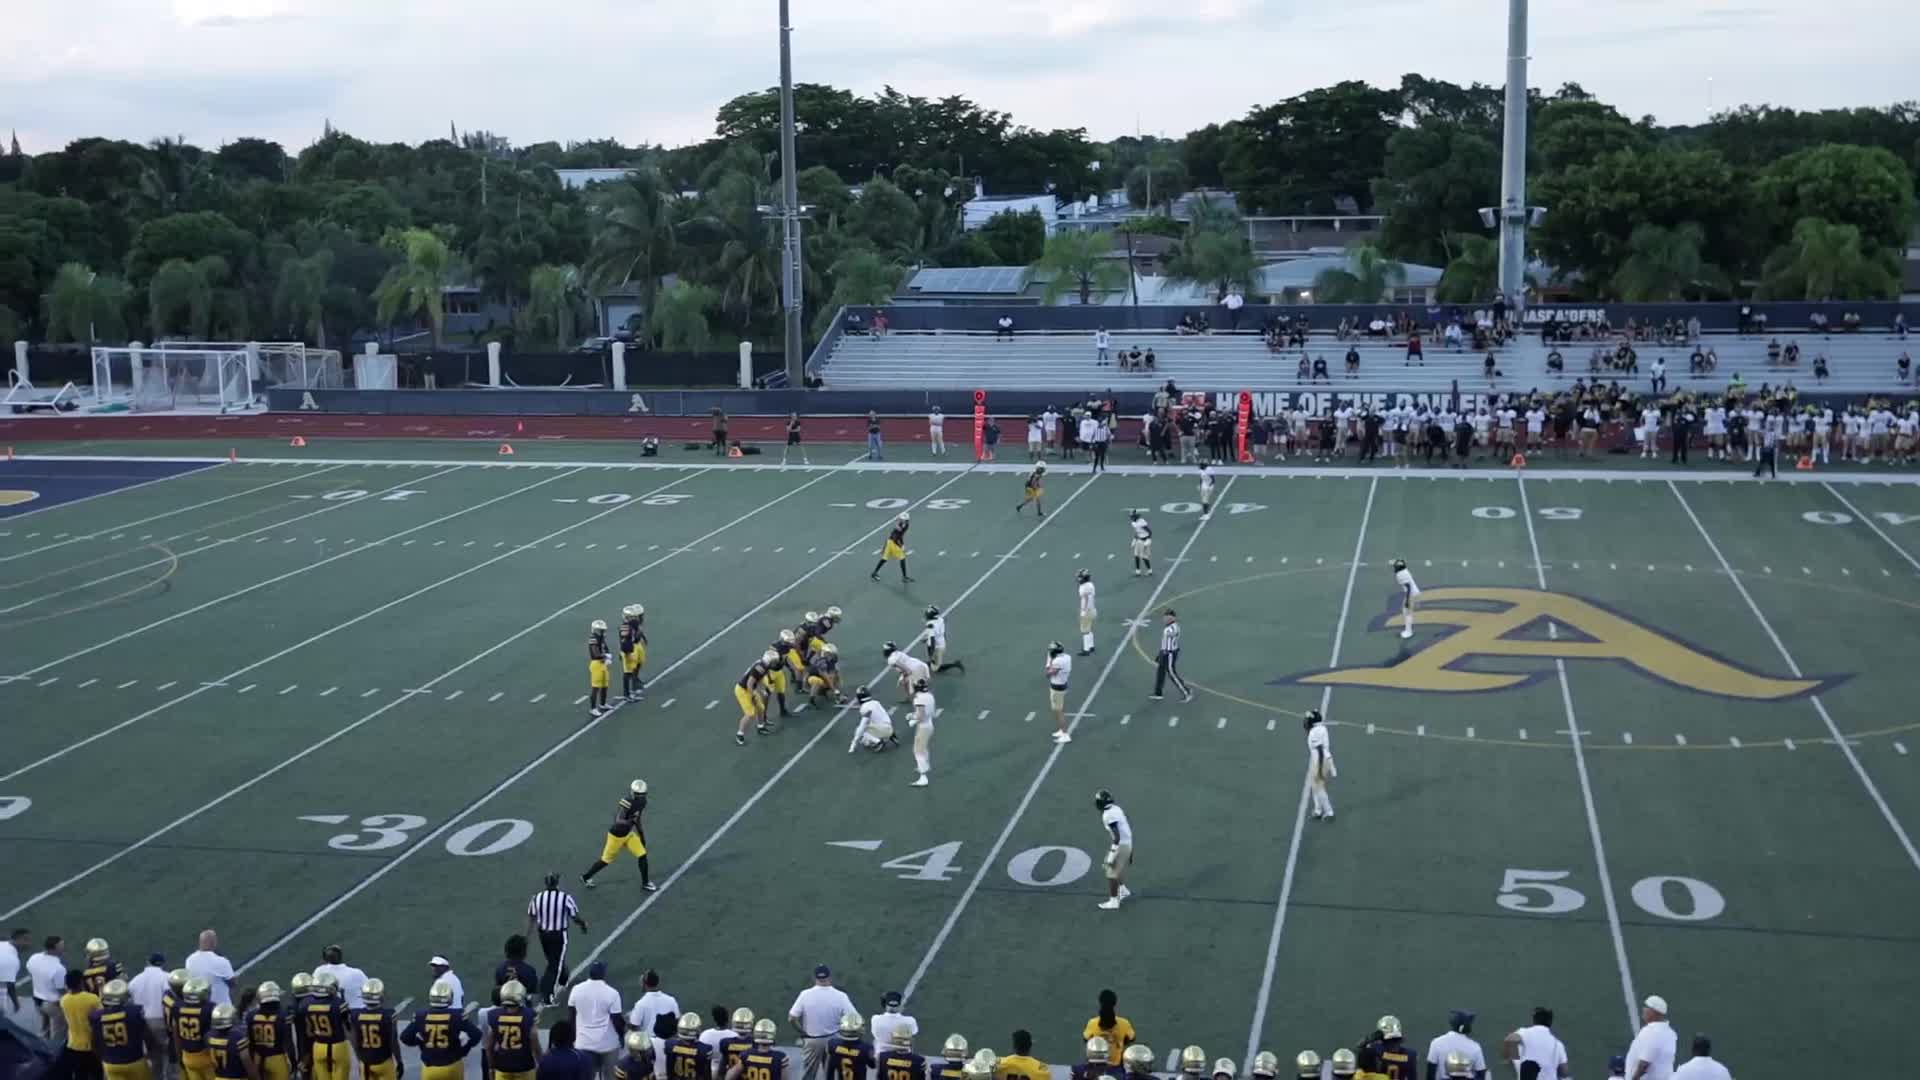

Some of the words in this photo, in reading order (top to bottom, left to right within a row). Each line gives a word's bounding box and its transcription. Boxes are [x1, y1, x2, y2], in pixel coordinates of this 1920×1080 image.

[328, 814, 534, 857] 30
[881, 841, 1093, 886] 40
[1496, 868, 1726, 921] 50
[102, 1021, 128, 1047] 59
[179, 1016, 202, 1041] 62
[360, 1023, 382, 1049] 16
[424, 1023, 449, 1049] 75
[498, 1025, 523, 1049] 72
